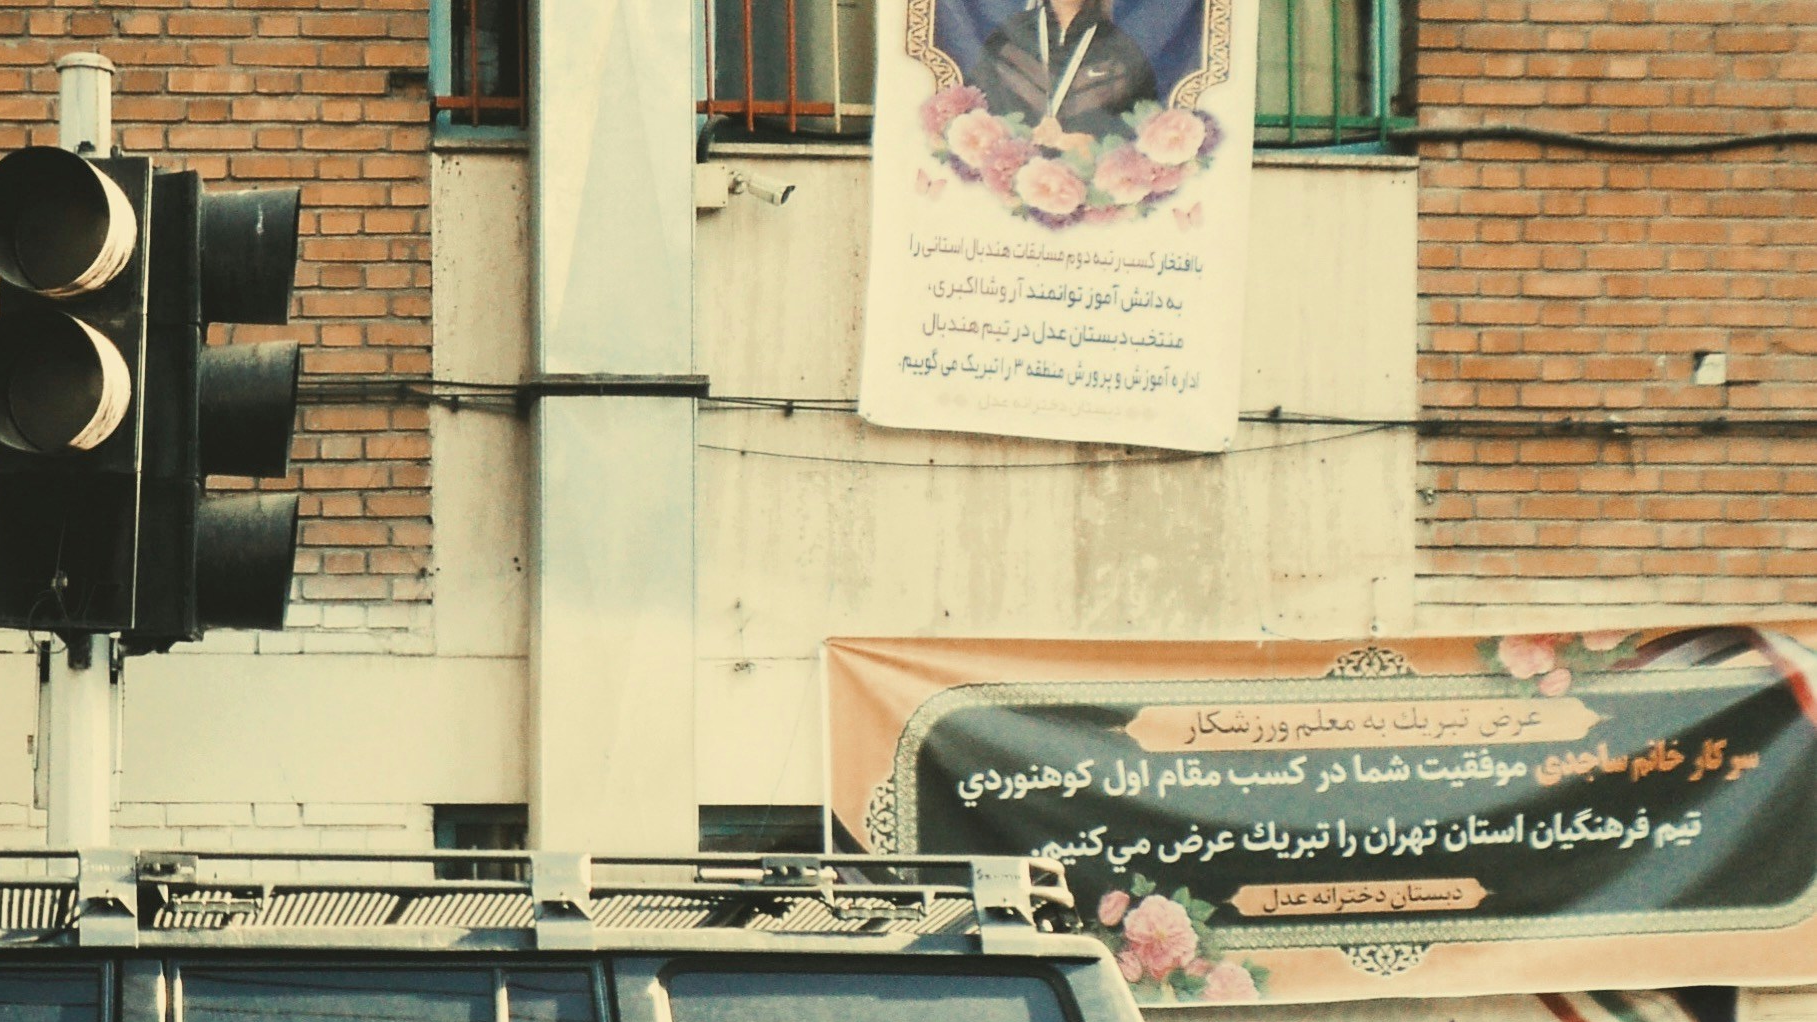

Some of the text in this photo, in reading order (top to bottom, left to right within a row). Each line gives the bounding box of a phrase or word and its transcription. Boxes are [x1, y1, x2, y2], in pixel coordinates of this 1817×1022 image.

[909, 233, 921, 257] را
[921, 235, 964, 258] استانی
[965, 238, 1010, 263] هندبال
[1013, 242, 1064, 267] مسابقات
[1066, 250, 1091, 270] دوم
[1092, 250, 1122, 272] رتبه
[1122, 251, 1155, 274] کسب
[1026, 283, 1083, 308] توانمند
[1085, 283, 1120, 310] آموز
[1121, 286, 1164, 312] دانش
[1166, 298, 1183, 317] به
[921, 312, 1184, 353] منتخب دبستان عدل در تیم هندبال
[960, 353, 999, 380] تبریک
[1000, 357, 1012, 381] را
[1026, 358, 1064, 379] منطقه
[1067, 360, 1113, 393] پرورش
[1114, 371, 1122, 390] و
[1123, 365, 1170, 392] آموزش
[1171, 370, 1200, 394] اداره
[1183, 709, 1290, 745] ورزشکار
[1294, 708, 1356, 738] معلم
[1362, 716, 1388, 738] به
[1478, 705, 1543, 737] عرض
[1227, 754, 1308, 796] کسب
[1353, 747, 1411, 785] شما
[1416, 748, 1528, 787] موفقیت
[1533, 742, 1630, 787] ساجدی
[1631, 739, 1686, 783] خانم
[1687, 738, 1761, 783] سرکار
[1102, 757, 1151, 798] اول
[1157, 757, 1222, 799] مقام
[1315, 760, 1347, 793] در
[1157, 822, 1236, 863] عرض
[1337, 818, 1357, 858] را
[1363, 816, 1438, 857] تهران
[1442, 812, 1524, 853] استان
[1528, 806, 1650, 851] فرهنگیان
[1653, 808, 1702, 849] تیم
[1262, 882, 1465, 913] دبستان دخترانه عدل
